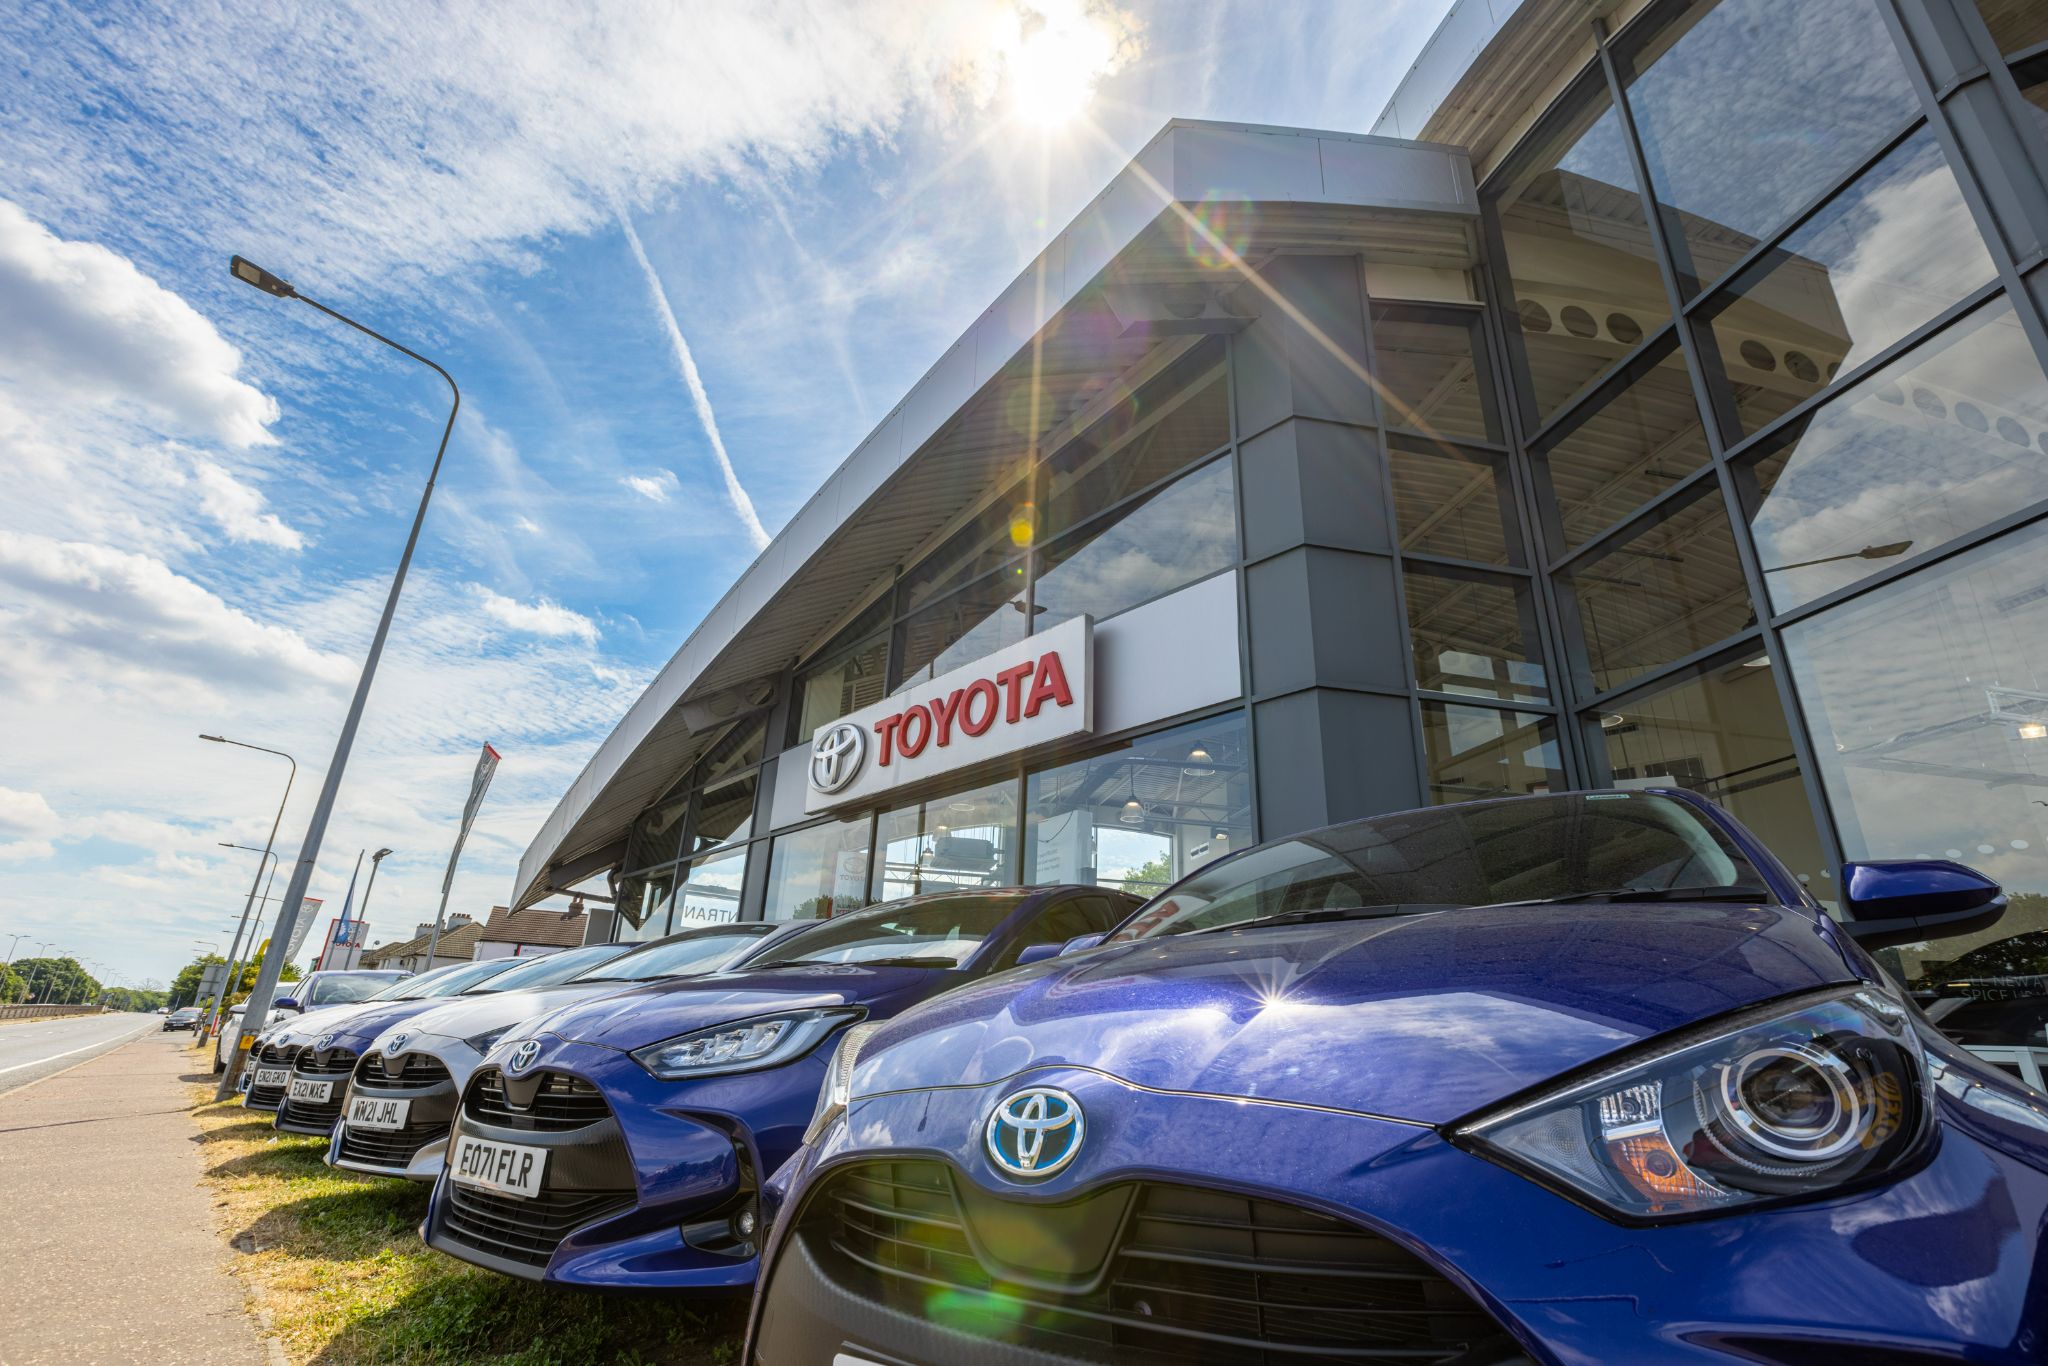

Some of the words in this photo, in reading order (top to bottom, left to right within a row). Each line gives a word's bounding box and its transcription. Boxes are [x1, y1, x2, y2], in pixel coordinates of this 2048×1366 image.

[874, 651, 1073, 767] TOYOTA
[1993, 975, 2028, 987] NEW
[292, 1081, 309, 1097] EX21
[309, 1082, 328, 1099] MXE
[376, 1102, 398, 1124] JHL
[459, 1143, 497, 1180] EO71
[495, 1149, 534, 1188] FLR
